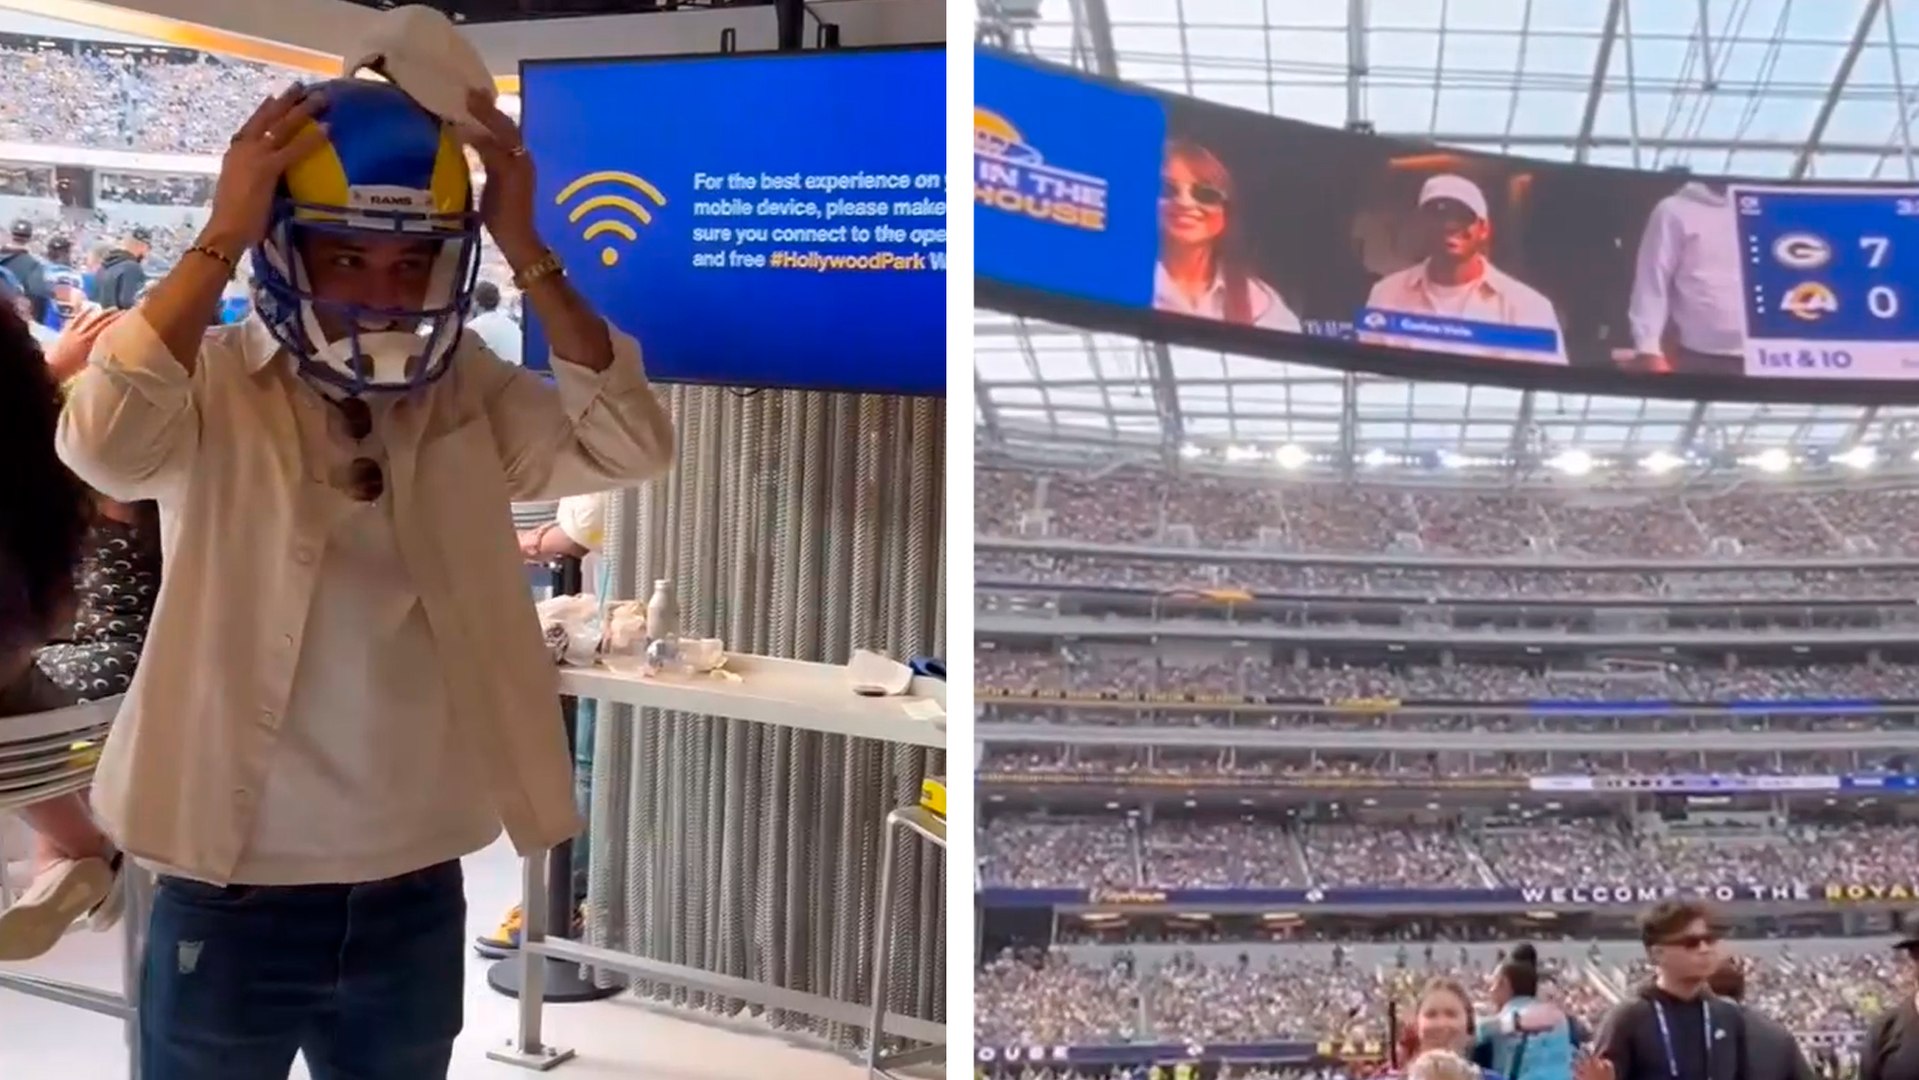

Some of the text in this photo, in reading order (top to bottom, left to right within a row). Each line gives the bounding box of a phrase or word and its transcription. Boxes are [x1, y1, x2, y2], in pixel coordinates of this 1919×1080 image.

[694, 171, 941, 194] For the best experience on
[979, 160, 1106, 208] IN THE
[370, 195, 412, 206] RAMS
[693, 197, 946, 220] mobile device, please make
[692, 227, 732, 242] sure
[735, 229, 768, 245] you
[771, 226, 847, 242] connect
[851, 226, 870, 242] to
[874, 224, 907, 242] the
[692, 251, 726, 267] and
[729, 250, 766, 267] free
[769, 251, 926, 272] #HollywoodPark
[1858, 237, 1890, 268] 7
[1867, 286, 1898, 319] 0
[1758, 349, 1852, 369] 1st & 10
[1521, 886, 1677, 903] WELCOME
[1693, 886, 1734, 902] TO
[1752, 884, 1810, 900] THE
